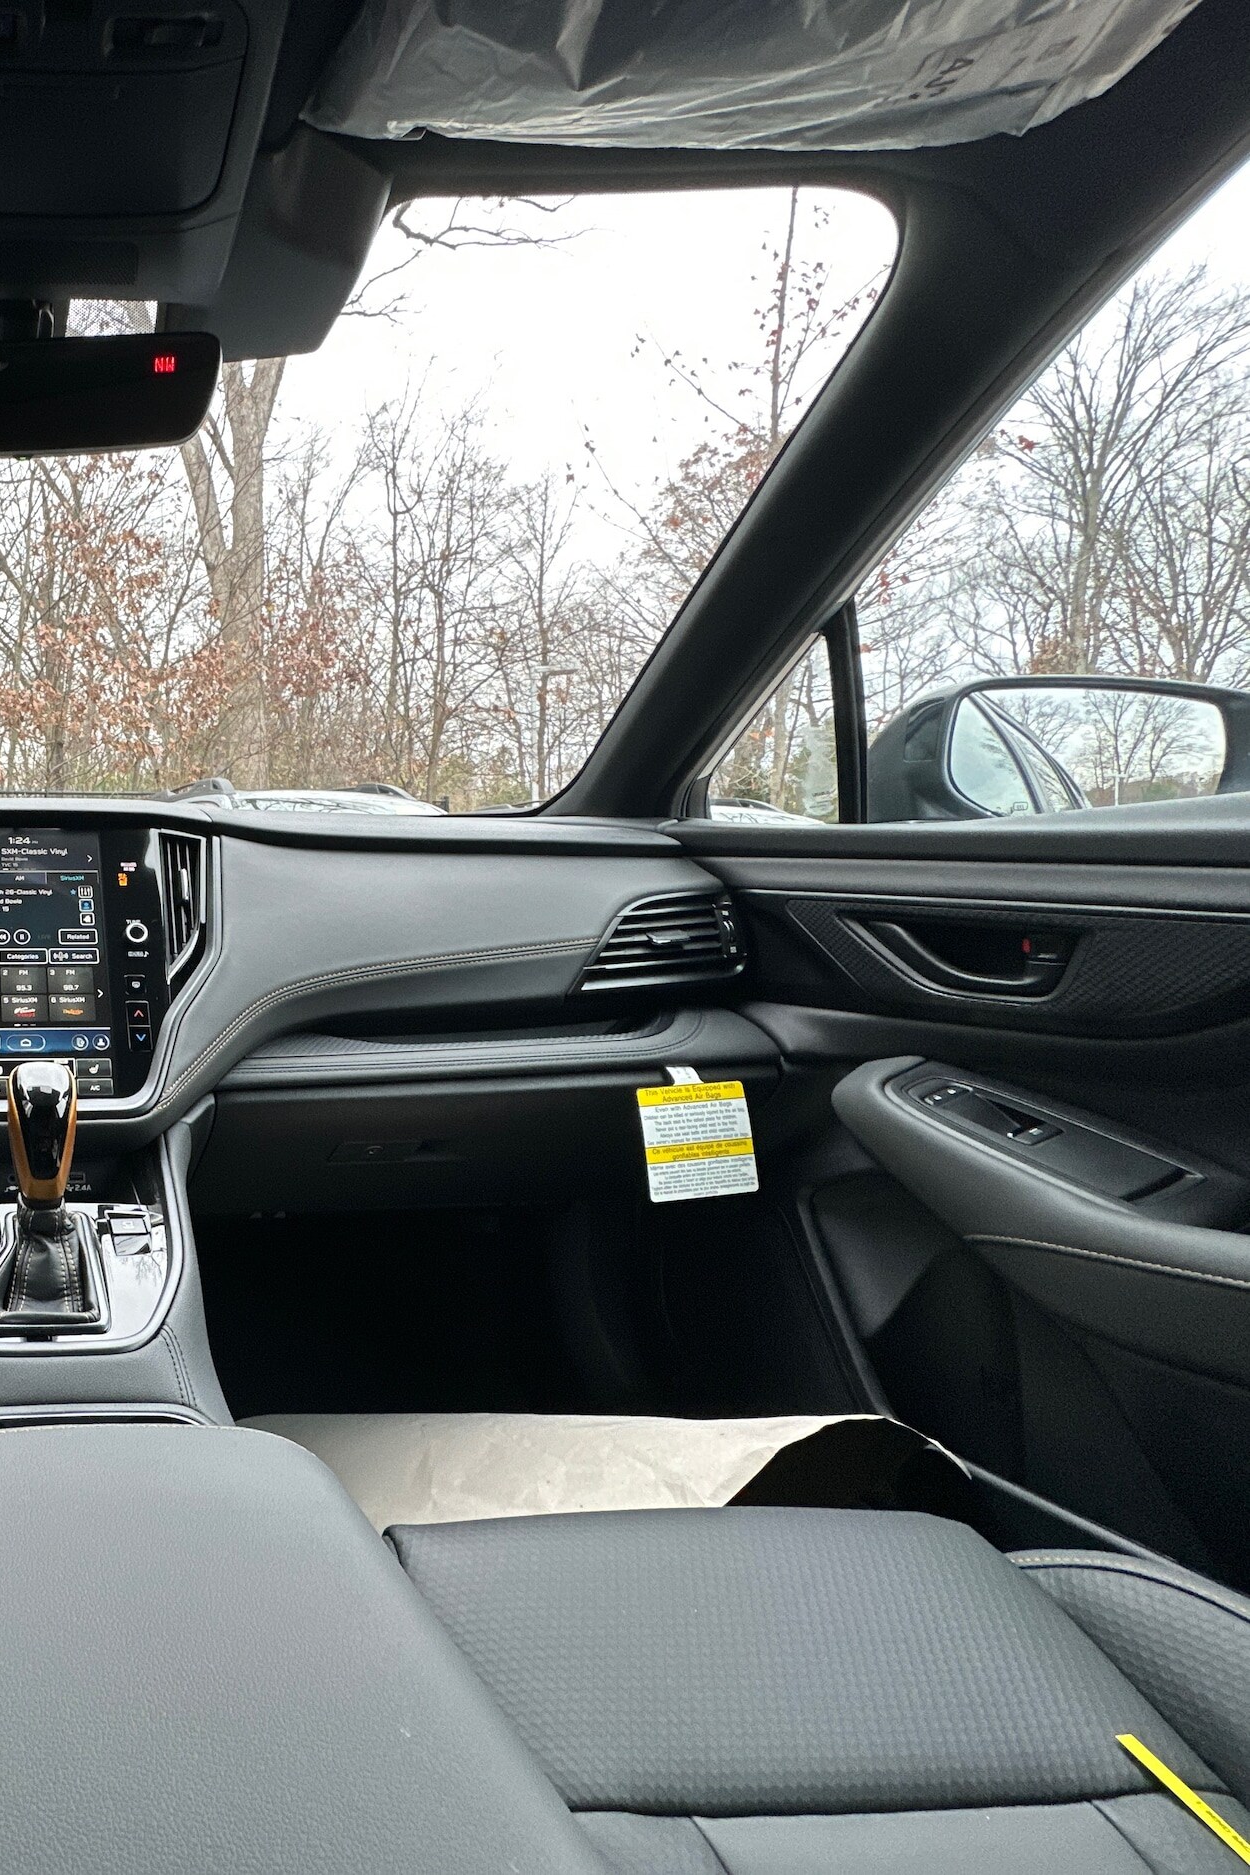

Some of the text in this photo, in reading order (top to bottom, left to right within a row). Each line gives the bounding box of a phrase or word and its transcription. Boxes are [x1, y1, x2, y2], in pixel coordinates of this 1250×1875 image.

[154, 356, 175, 373] NW
[50, 848, 68, 856] Vinyl
[692, 1084, 720, 1093] Equipped
